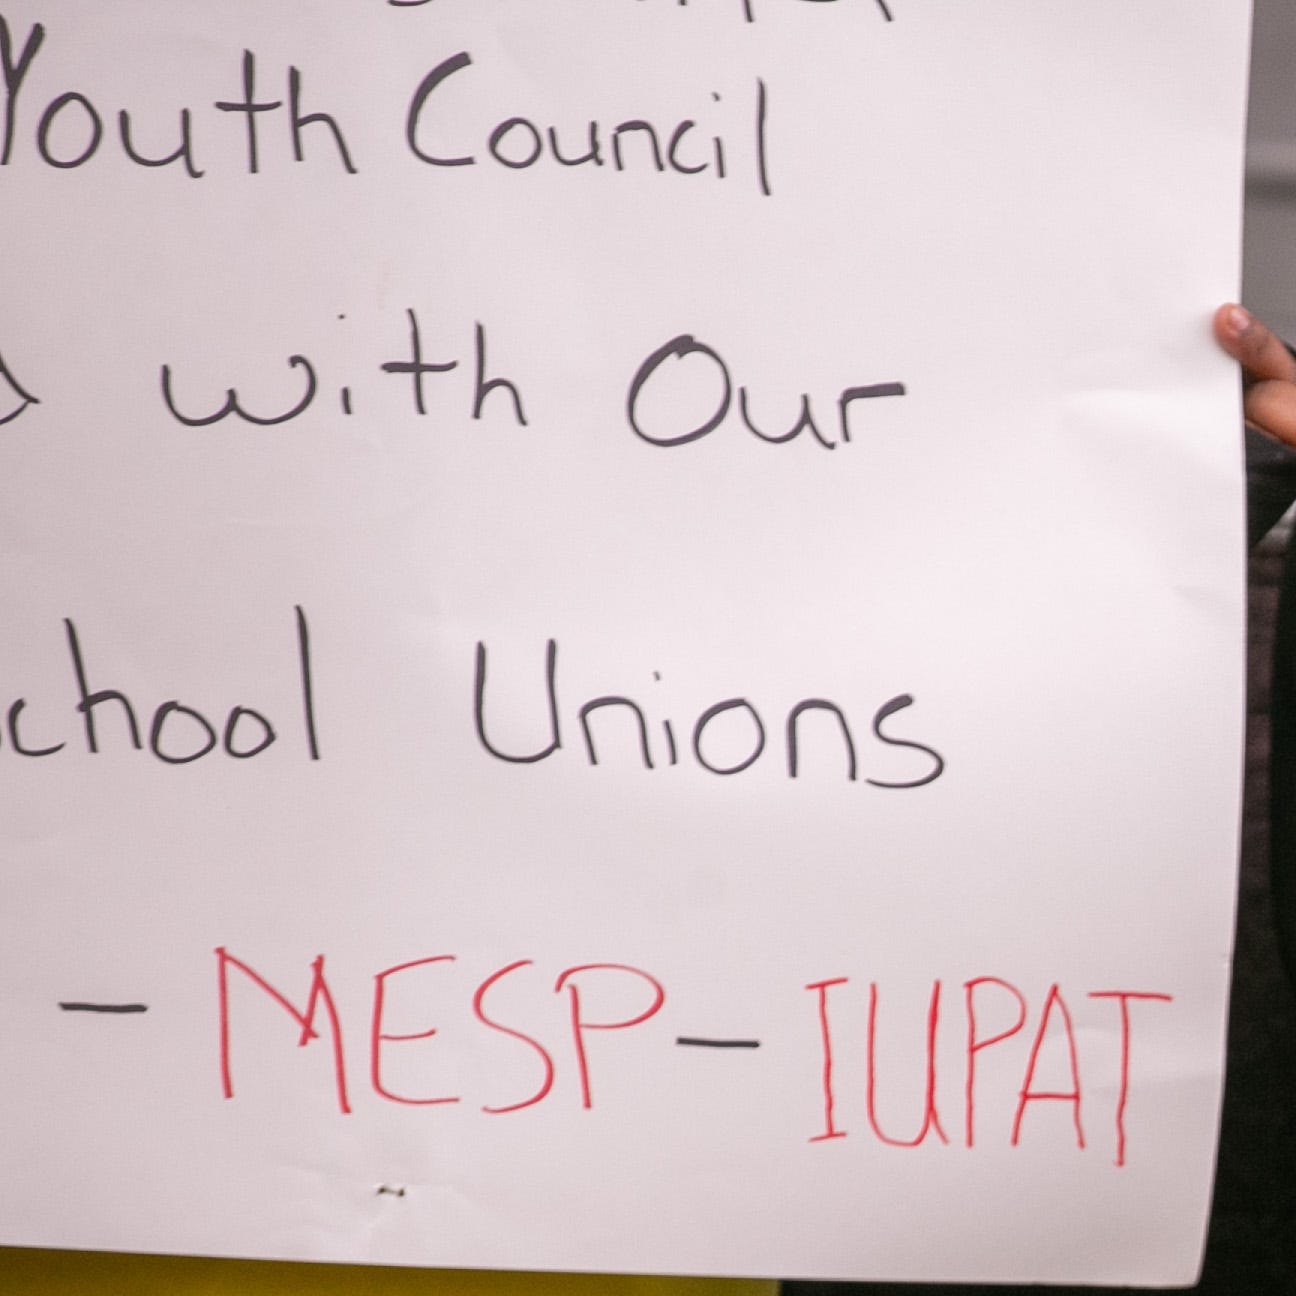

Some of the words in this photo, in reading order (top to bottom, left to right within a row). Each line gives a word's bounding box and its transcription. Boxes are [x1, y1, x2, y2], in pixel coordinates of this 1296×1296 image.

[0, 14, 358, 178] Youth
[404, 50, 772, 197] Council
[160, 306, 529, 427] with
[626, 333, 907, 451] Our
[0, 604, 321, 766] chool
[473, 639, 946, 790] Unions
